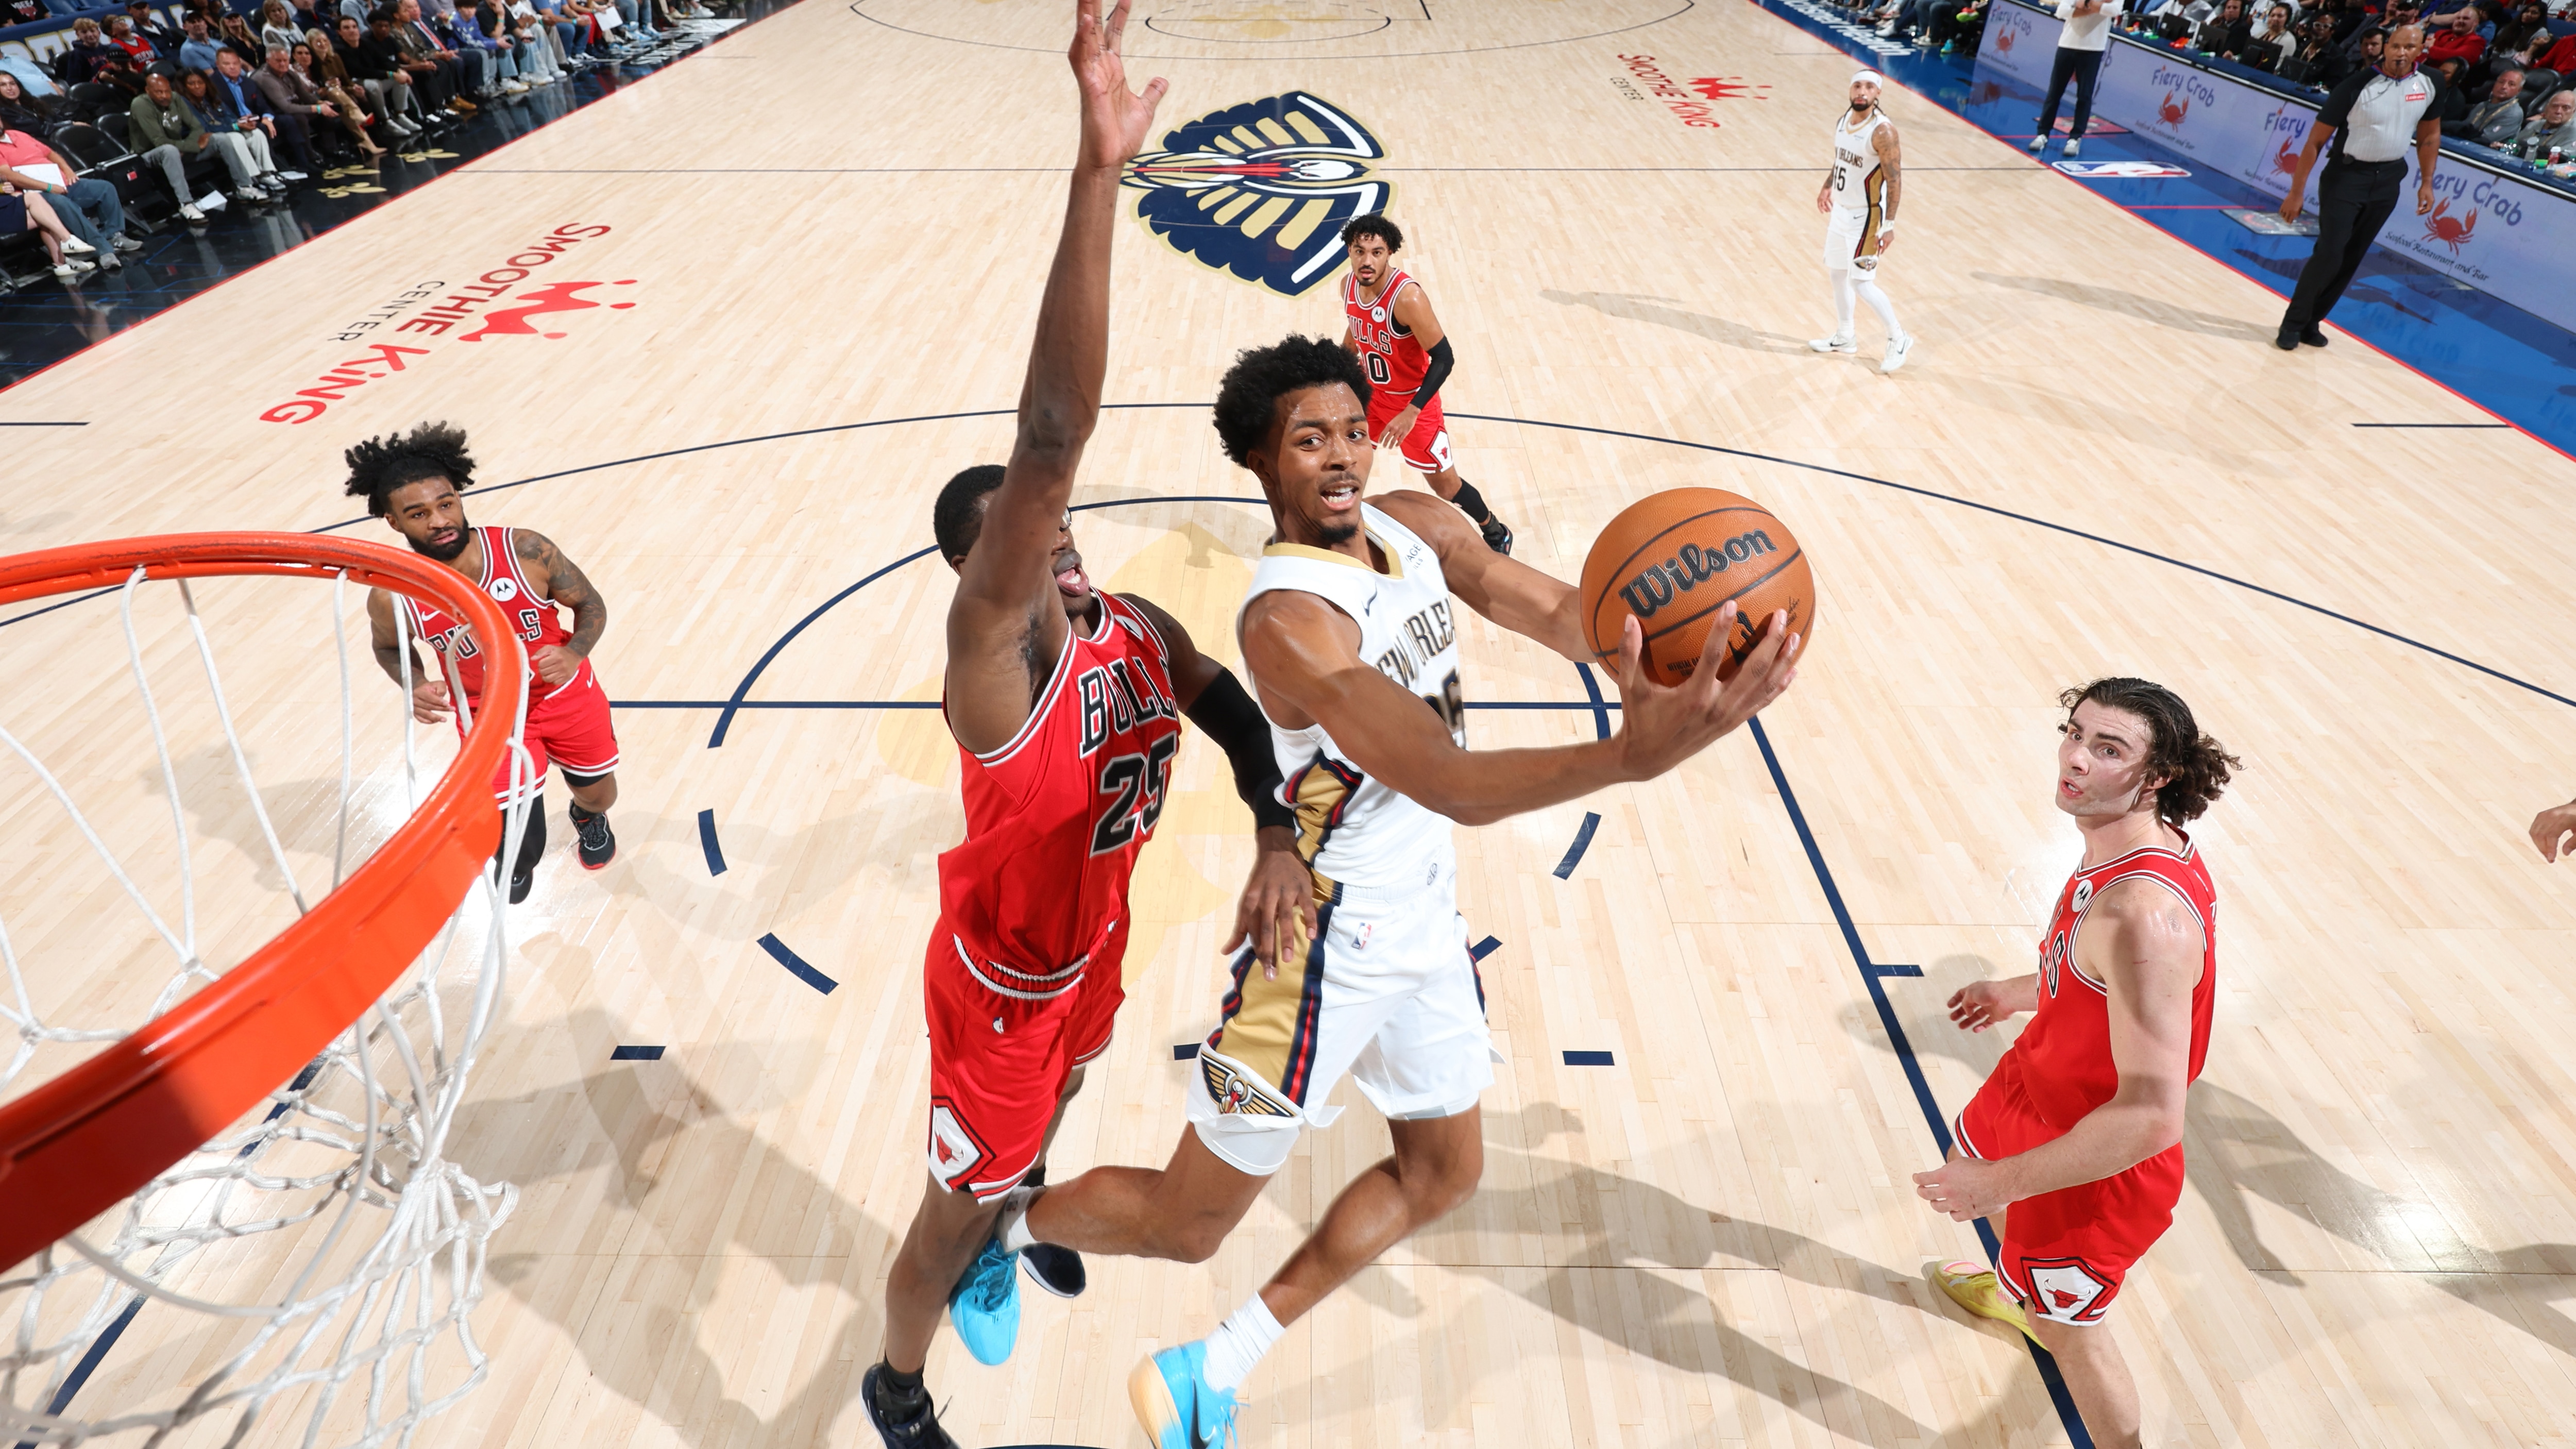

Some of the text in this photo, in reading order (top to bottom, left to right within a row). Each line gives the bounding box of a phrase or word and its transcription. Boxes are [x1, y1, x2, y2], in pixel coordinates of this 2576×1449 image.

[1610, 77, 1644, 100] CENTER
[1617, 54, 1689, 98] SMOOTHIE
[2151, 64, 2214, 107] Fiery Crab
[2264, 107, 2307, 139] Fiery
[2412, 168, 2521, 226] Fery Crab
[395, 222, 611, 335] SMOOTHIE
[327, 280, 446, 342] CENTER
[1347, 314, 1393, 355] ULLS
[1618, 528, 1778, 618] Wilson
[1079, 655, 1180, 759] BULL
[1089, 731, 1179, 859] 25
